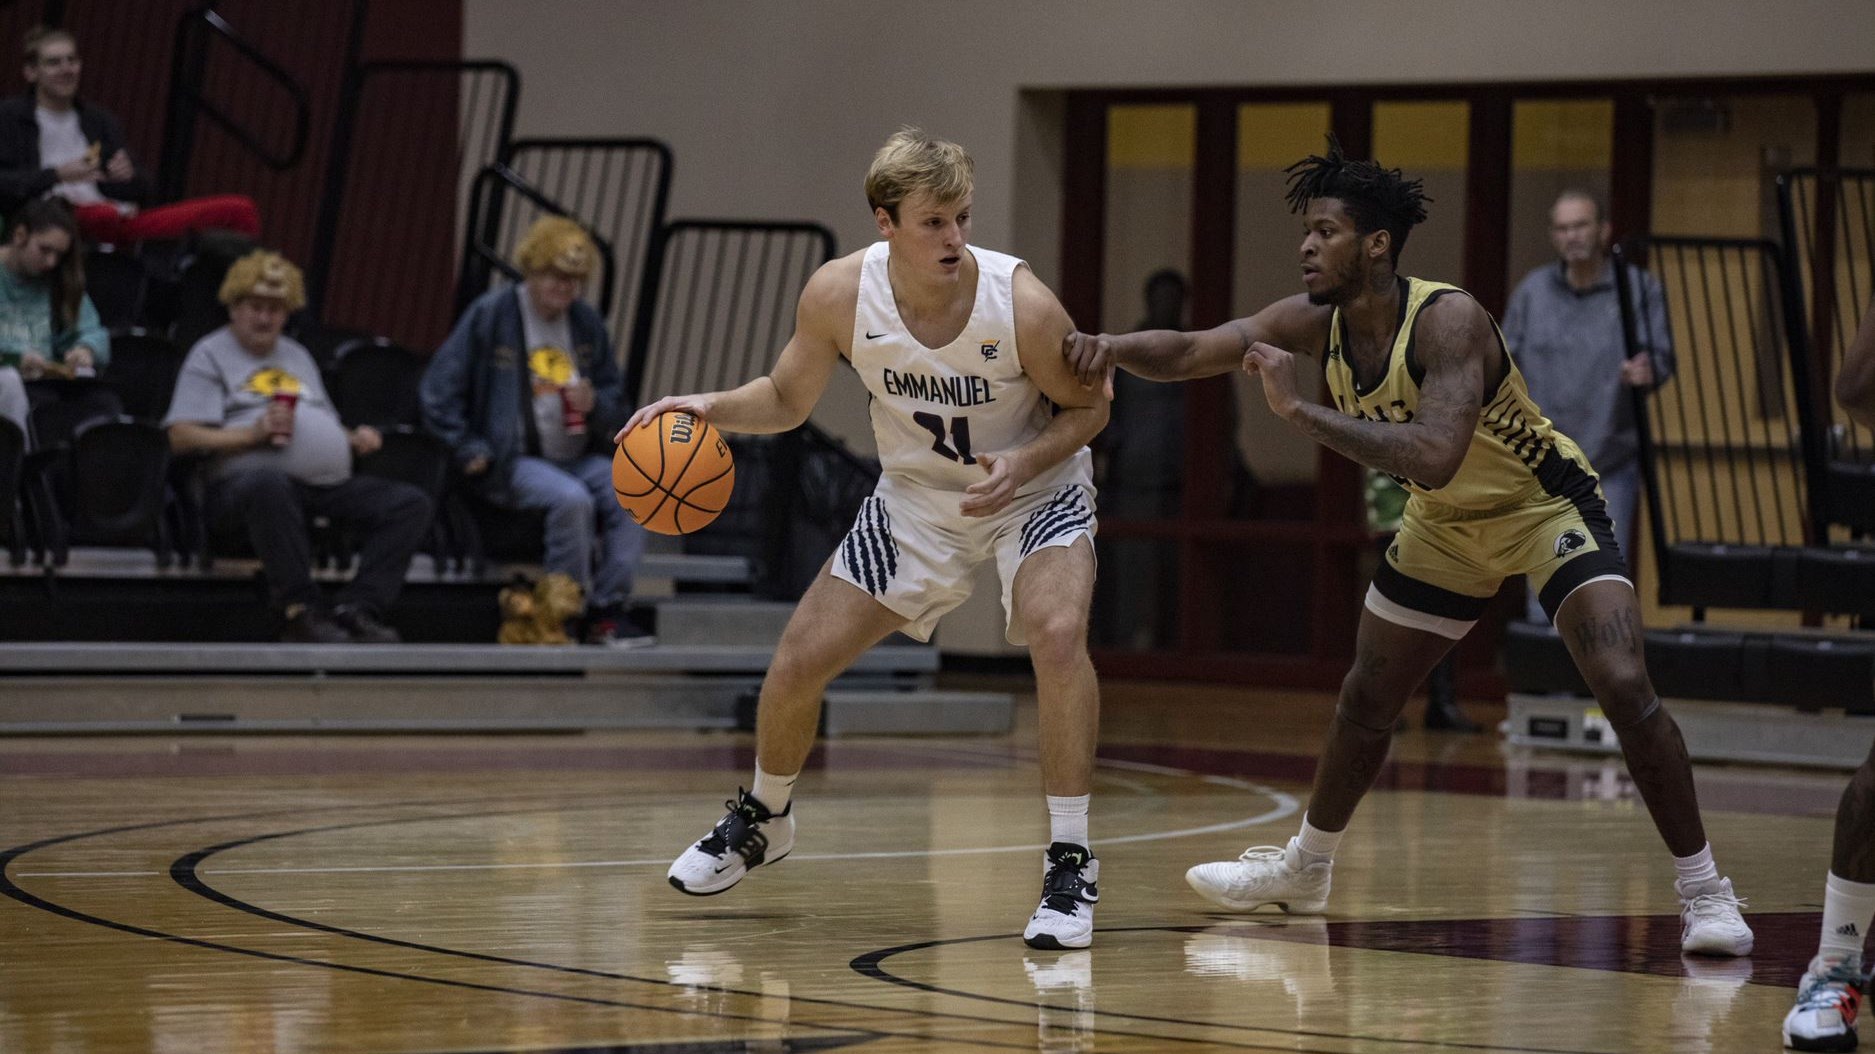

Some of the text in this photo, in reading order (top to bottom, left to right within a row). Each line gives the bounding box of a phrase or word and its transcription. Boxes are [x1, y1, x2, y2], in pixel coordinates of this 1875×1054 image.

[883, 368, 997, 407] EMMANUEL
[913, 411, 978, 465] 21
[1575, 608, 1636, 655] Wolf
